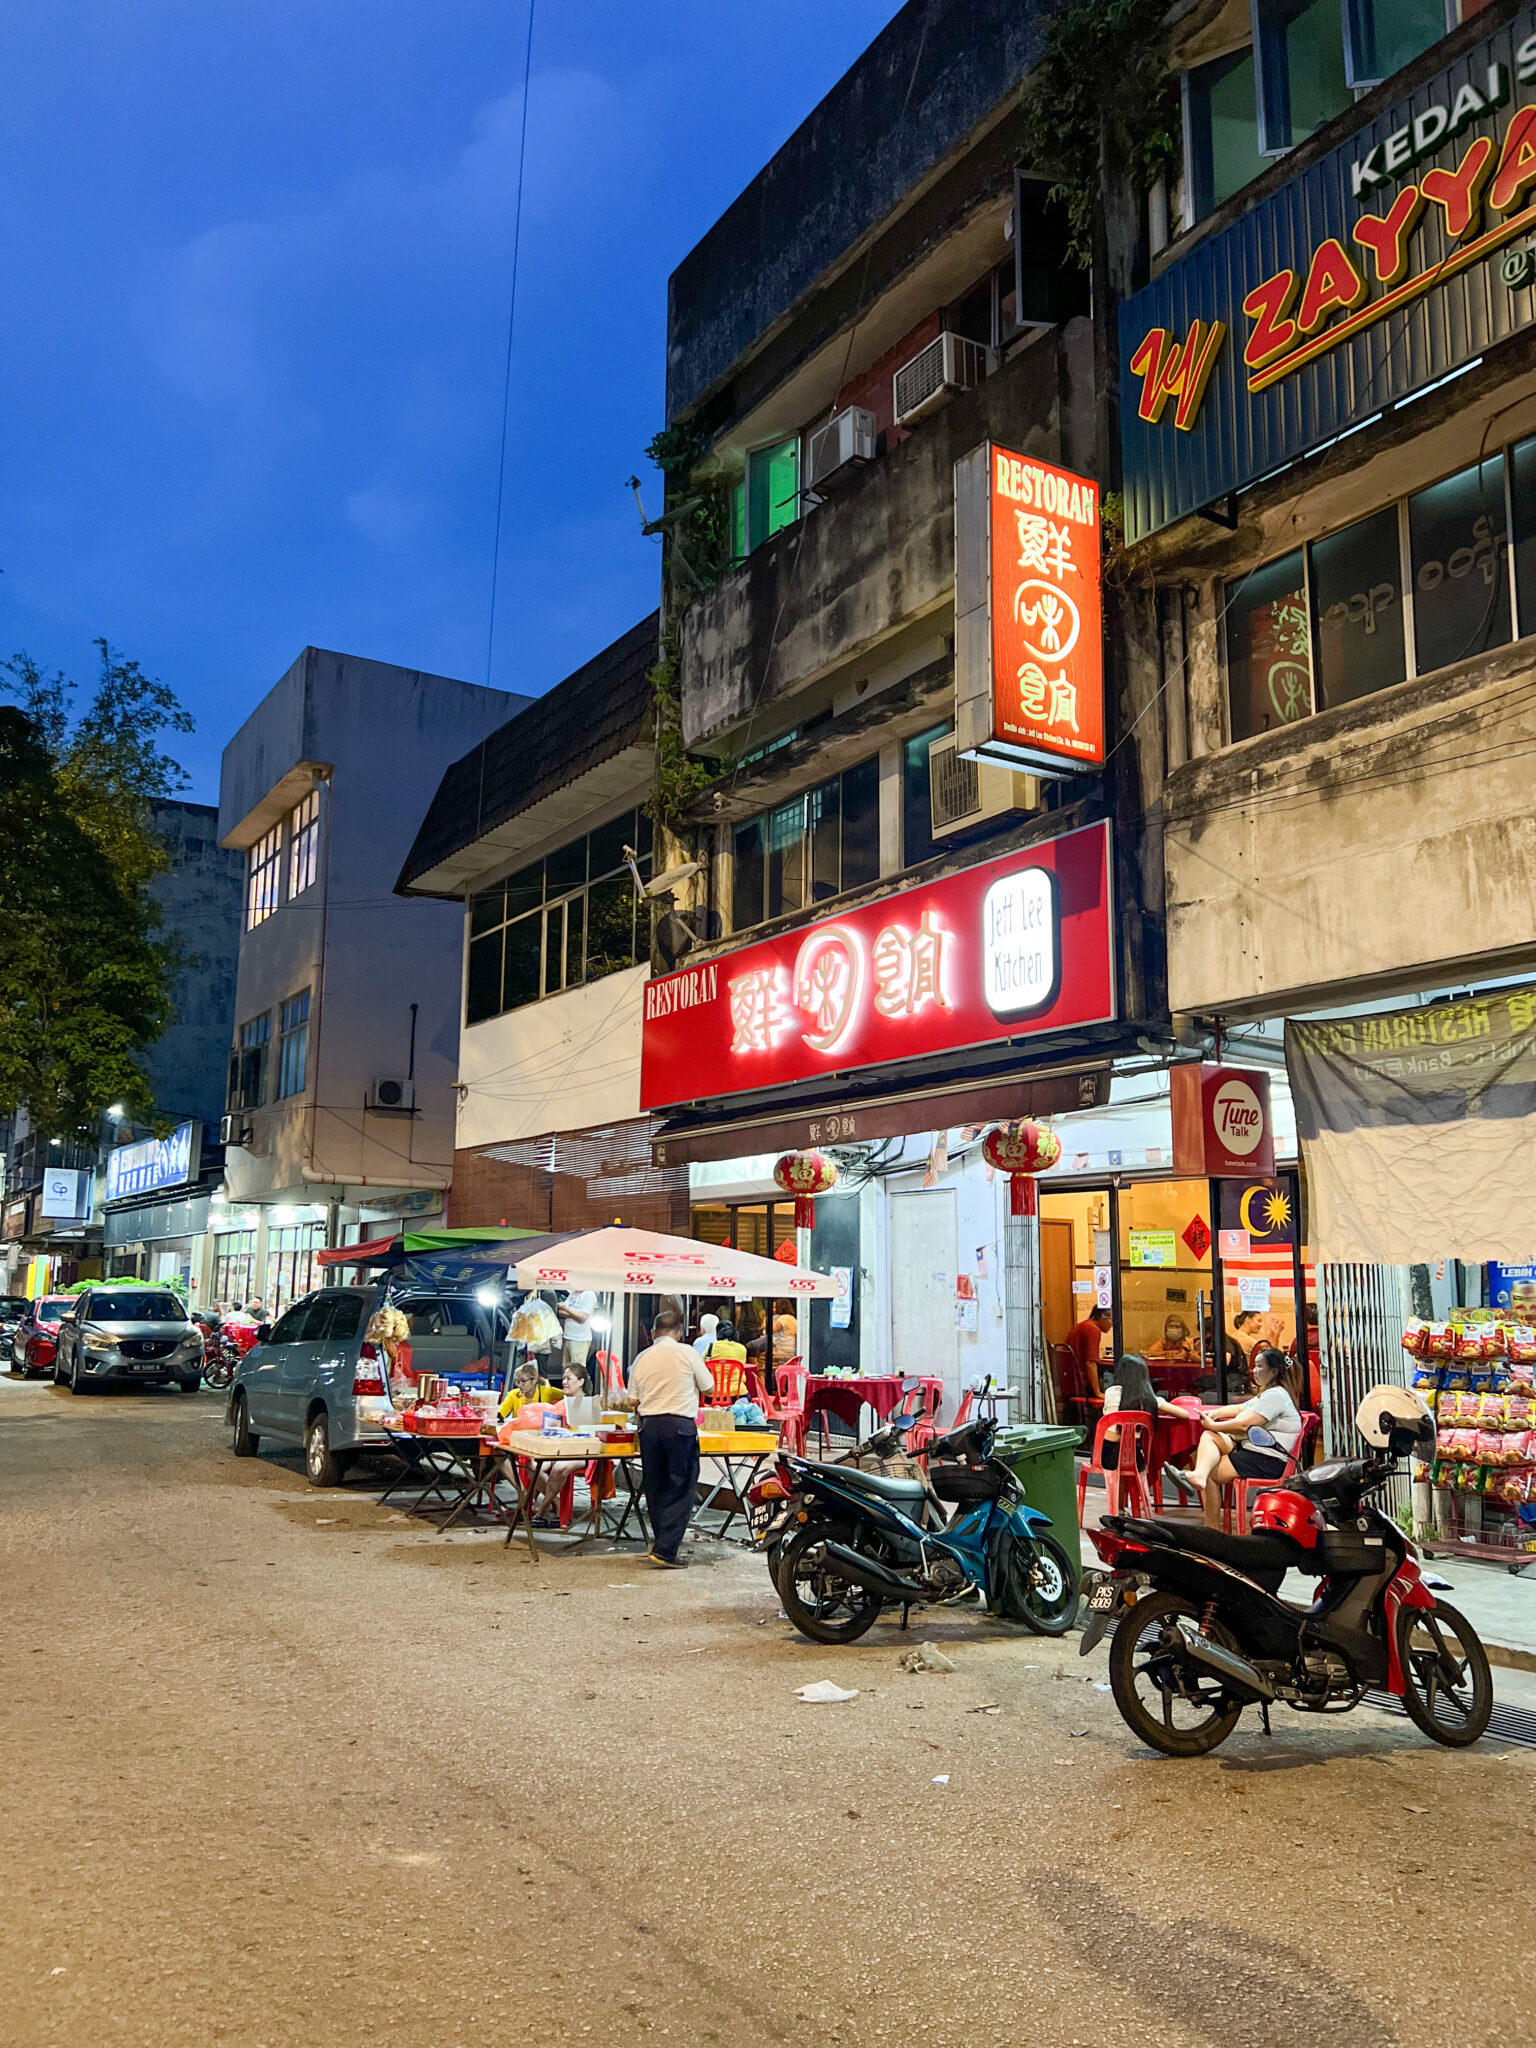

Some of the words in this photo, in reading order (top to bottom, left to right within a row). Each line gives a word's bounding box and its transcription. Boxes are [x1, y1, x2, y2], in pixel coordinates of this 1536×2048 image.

[1352, 62, 1500, 197] KEDAI
[996, 454, 1094, 527] RESTORAN
[989, 893, 1013, 947] Jeff
[1021, 888, 1043, 931] Lee
[994, 945, 1043, 993] Kitchen
[646, 963, 719, 1021] RESTORAN
[1218, 1098, 1260, 1133] Tune
[1230, 1125, 1250, 1137] Talk
[1224, 1160, 1258, 1168] tunetalk.com
[536, 1268, 569, 1281] SSS
[623, 1272, 656, 1285] SSS
[1501, 1267, 1533, 1278] LEBIH
[707, 1275, 738, 1288] SSS
[788, 1278, 818, 1291] SSS
[1167, 1292, 1185, 1300] OPEN
[750, 1512, 769, 1527] 1650
[1095, 1586, 1114, 1598] PKS
[1089, 1597, 1113, 1609] 9009
